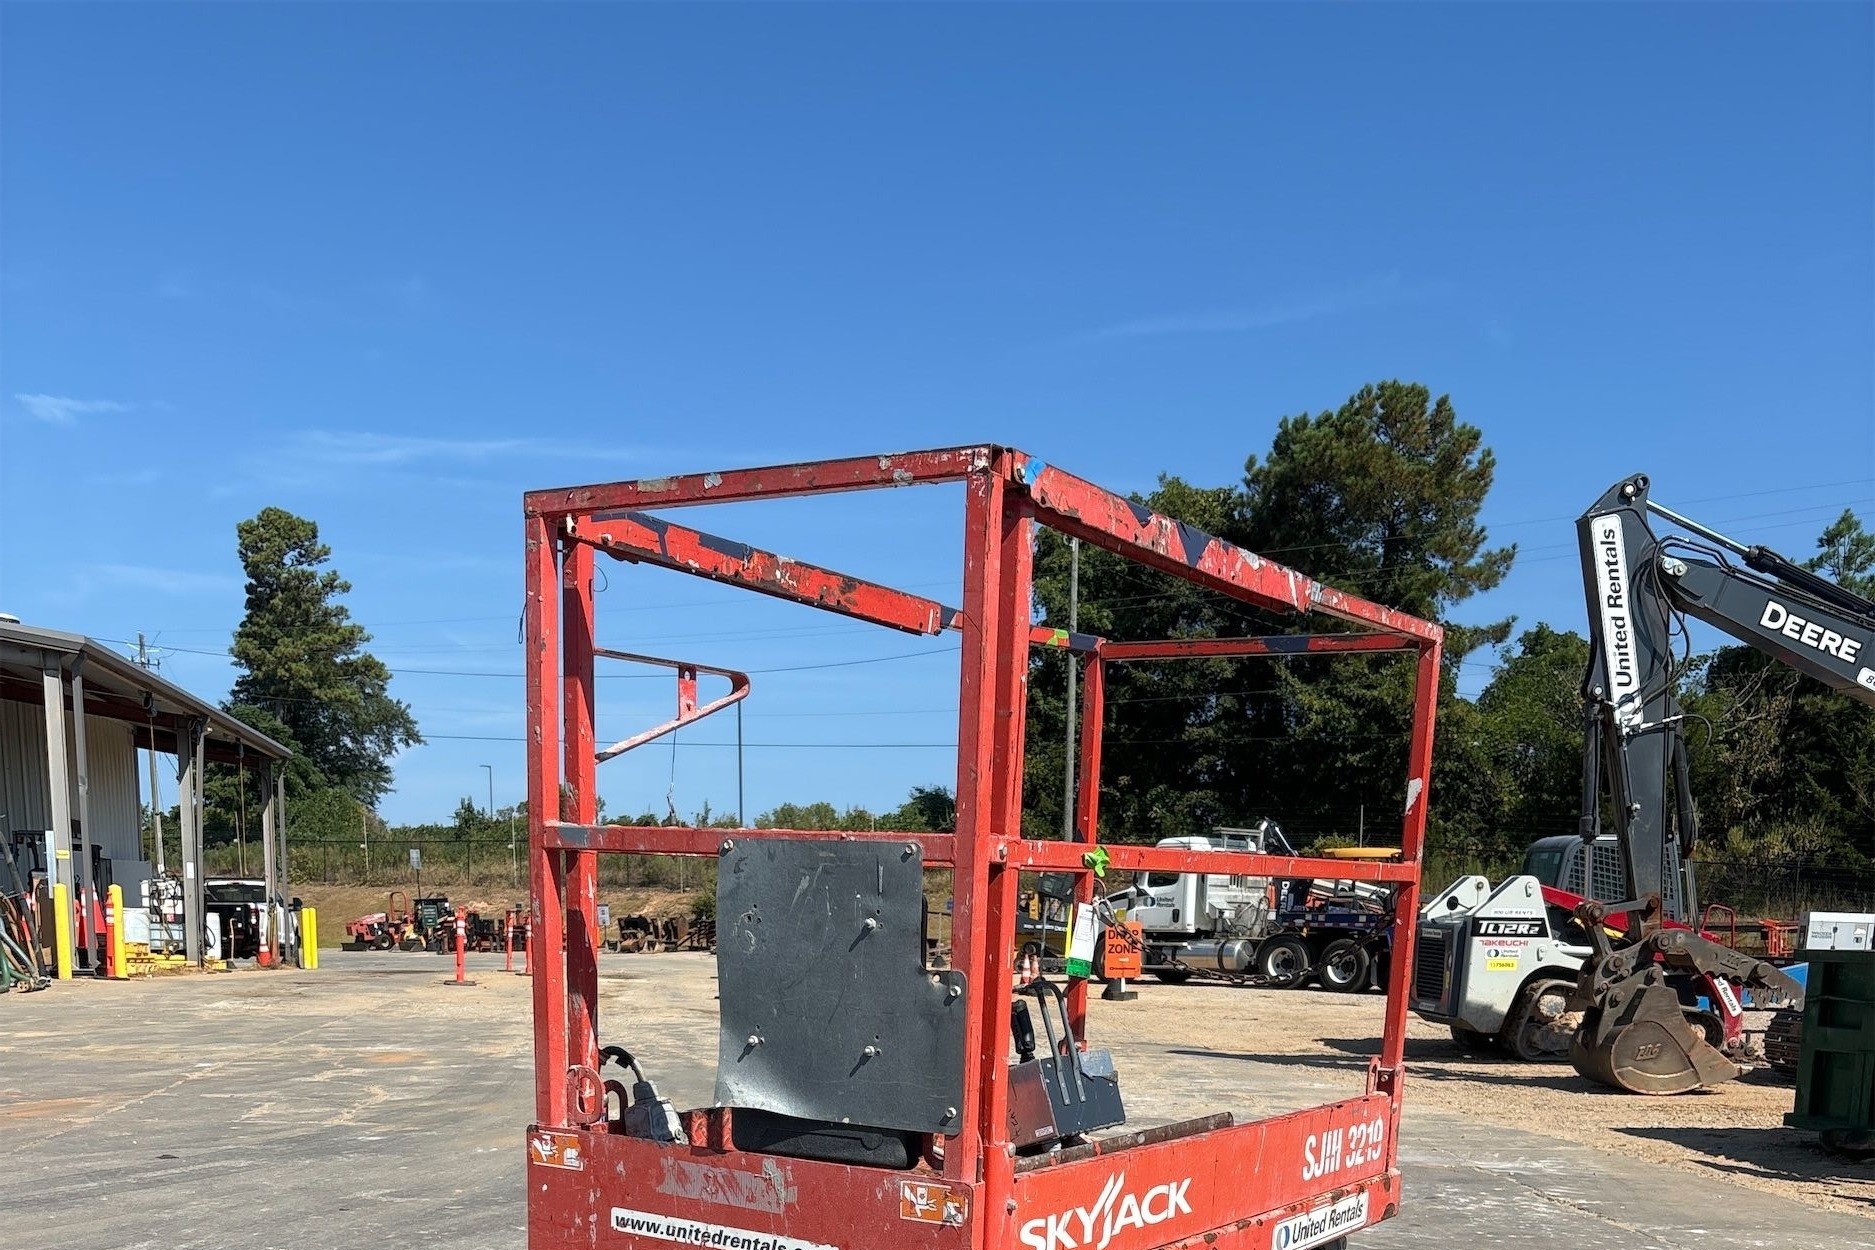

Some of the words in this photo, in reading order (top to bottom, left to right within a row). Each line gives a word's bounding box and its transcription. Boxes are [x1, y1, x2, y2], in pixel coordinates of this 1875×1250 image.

[1600, 528, 1623, 608] Rentals
[1611, 616, 1632, 687] United
[1759, 600, 1862, 664] DEERE
[1108, 944, 1138, 954] ZONE
[1479, 921, 1541, 935] TL12R2
[1346, 1118, 1383, 1169] 3219
[1292, 1212, 1327, 1243] United
[1328, 1199, 1363, 1230] Rentals
